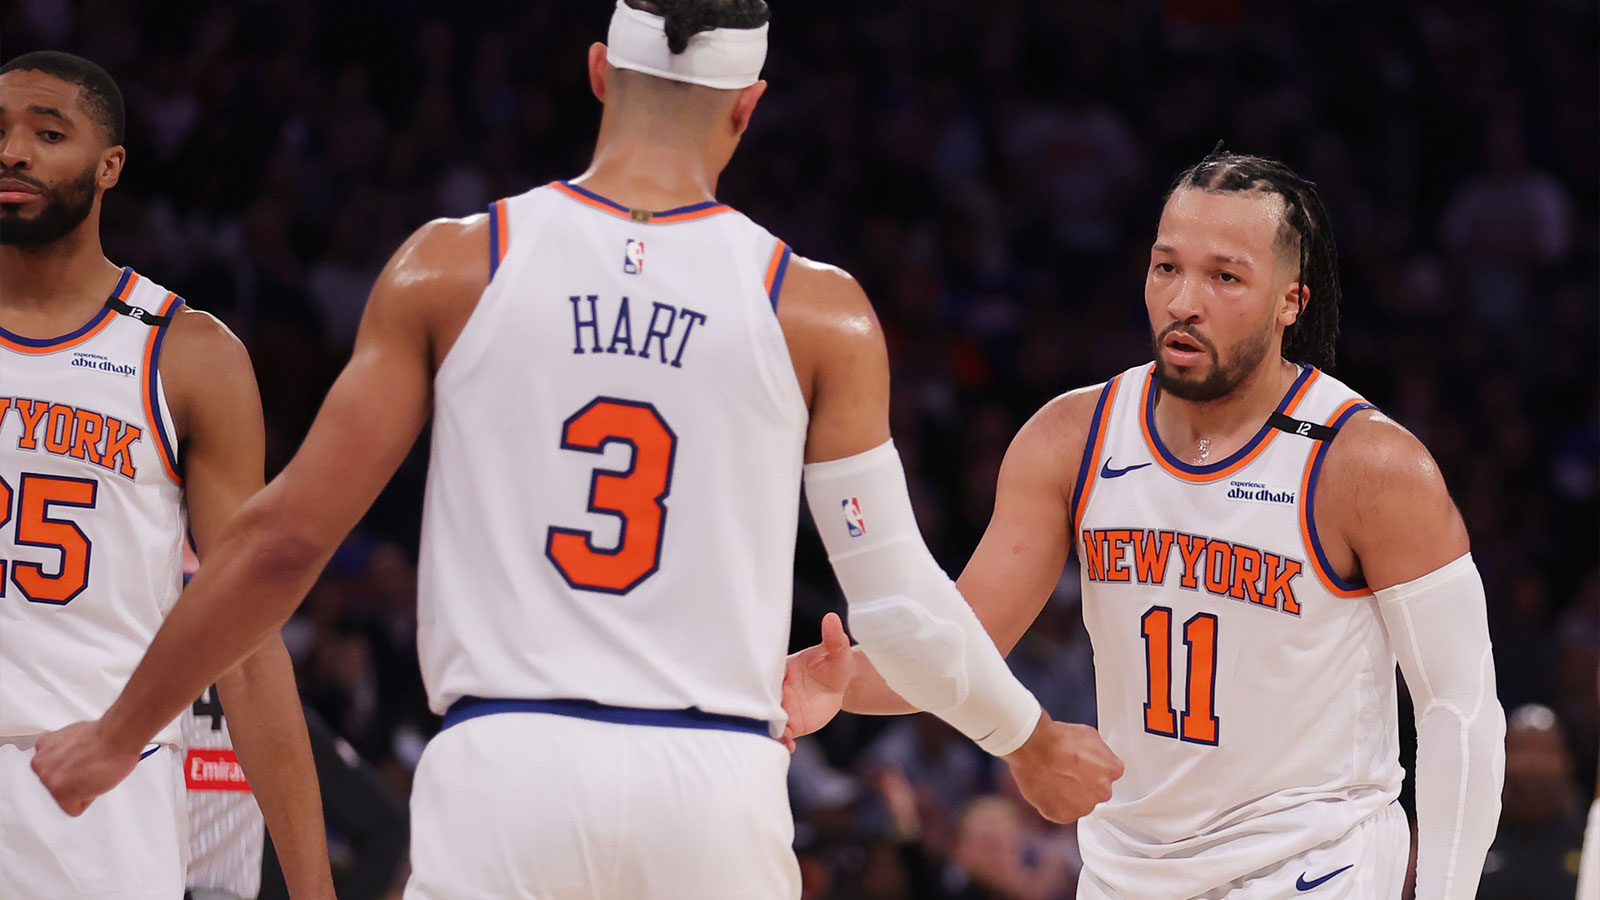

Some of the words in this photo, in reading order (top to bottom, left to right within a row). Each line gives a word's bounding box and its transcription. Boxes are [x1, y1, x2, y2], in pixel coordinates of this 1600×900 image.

[129, 307, 144, 319] 12
[569, 295, 707, 368] HART
[71, 357, 97, 370] abu
[99, 360, 136, 376] dhabi
[73, 352, 108, 361] experience
[15, 397, 142, 481] YORK
[1295, 421, 1313, 437] 12
[545, 395, 678, 596] 3
[1227, 487, 1253, 501] abu
[1255, 489, 1295, 505] dhabi
[1229, 480, 1266, 489] experience
[0, 472, 98, 606] 5
[1082, 528, 1175, 586] NEW
[1177, 530, 1305, 618] YORK
[1140, 605, 1220, 747] 11
